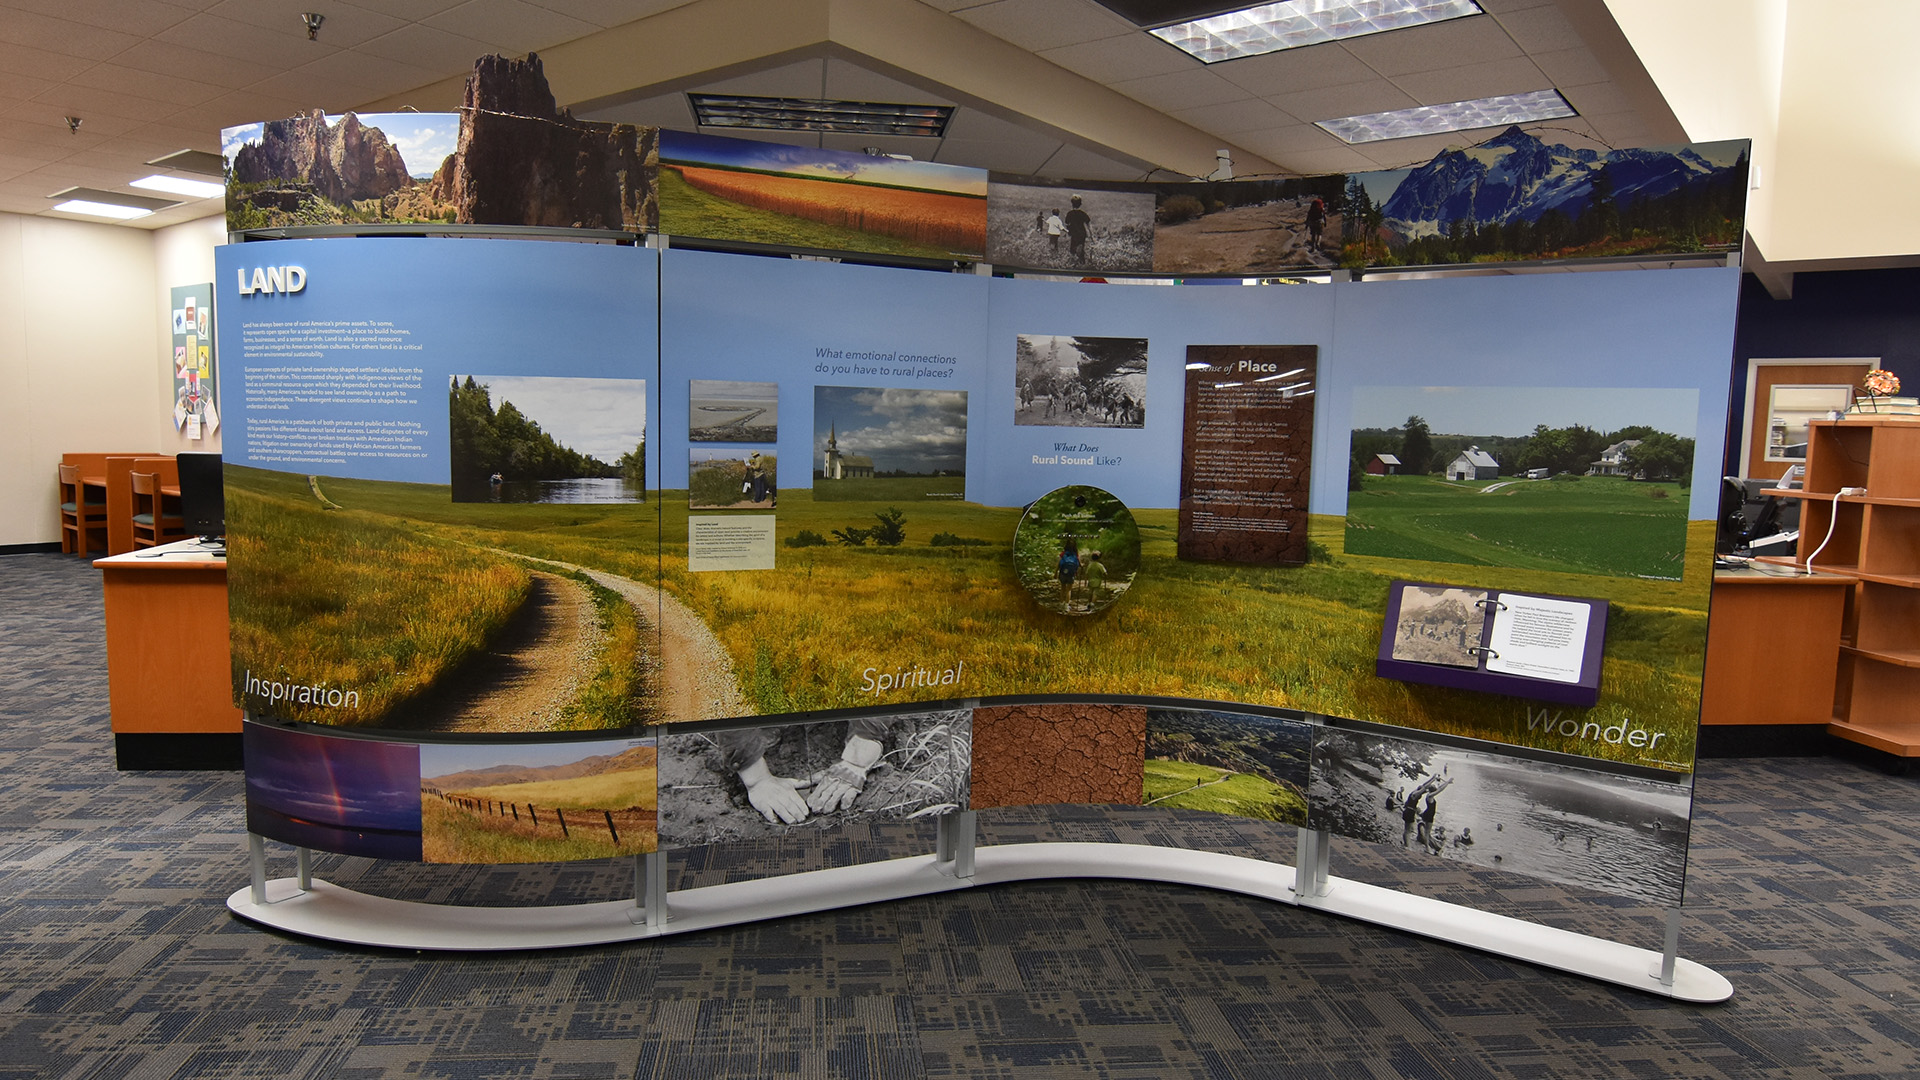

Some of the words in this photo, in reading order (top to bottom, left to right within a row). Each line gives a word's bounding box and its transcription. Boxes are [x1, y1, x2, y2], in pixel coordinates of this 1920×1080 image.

[238, 266, 307, 294] LAND
[816, 348, 842, 359] What
[846, 351, 896, 361] emotional
[898, 354, 956, 364] connections
[815, 363, 828, 372] do
[831, 365, 850, 375] you
[853, 364, 877, 375] have
[880, 367, 890, 376] to
[892, 367, 914, 376] rural
[916, 367, 953, 378] places?
[1224, 363, 1235, 375] of
[1238, 360, 1277, 372] Place
[1054, 443, 1077, 452] What
[1079, 443, 1099, 452] Does
[1032, 455, 1058, 465] Rural
[1061, 456, 1093, 465] Sound
[1096, 457, 1121, 465] Like?
[861, 660, 963, 697] Spiritual
[245, 669, 359, 708] Inspiration
[1527, 706, 1665, 749] Wonder
